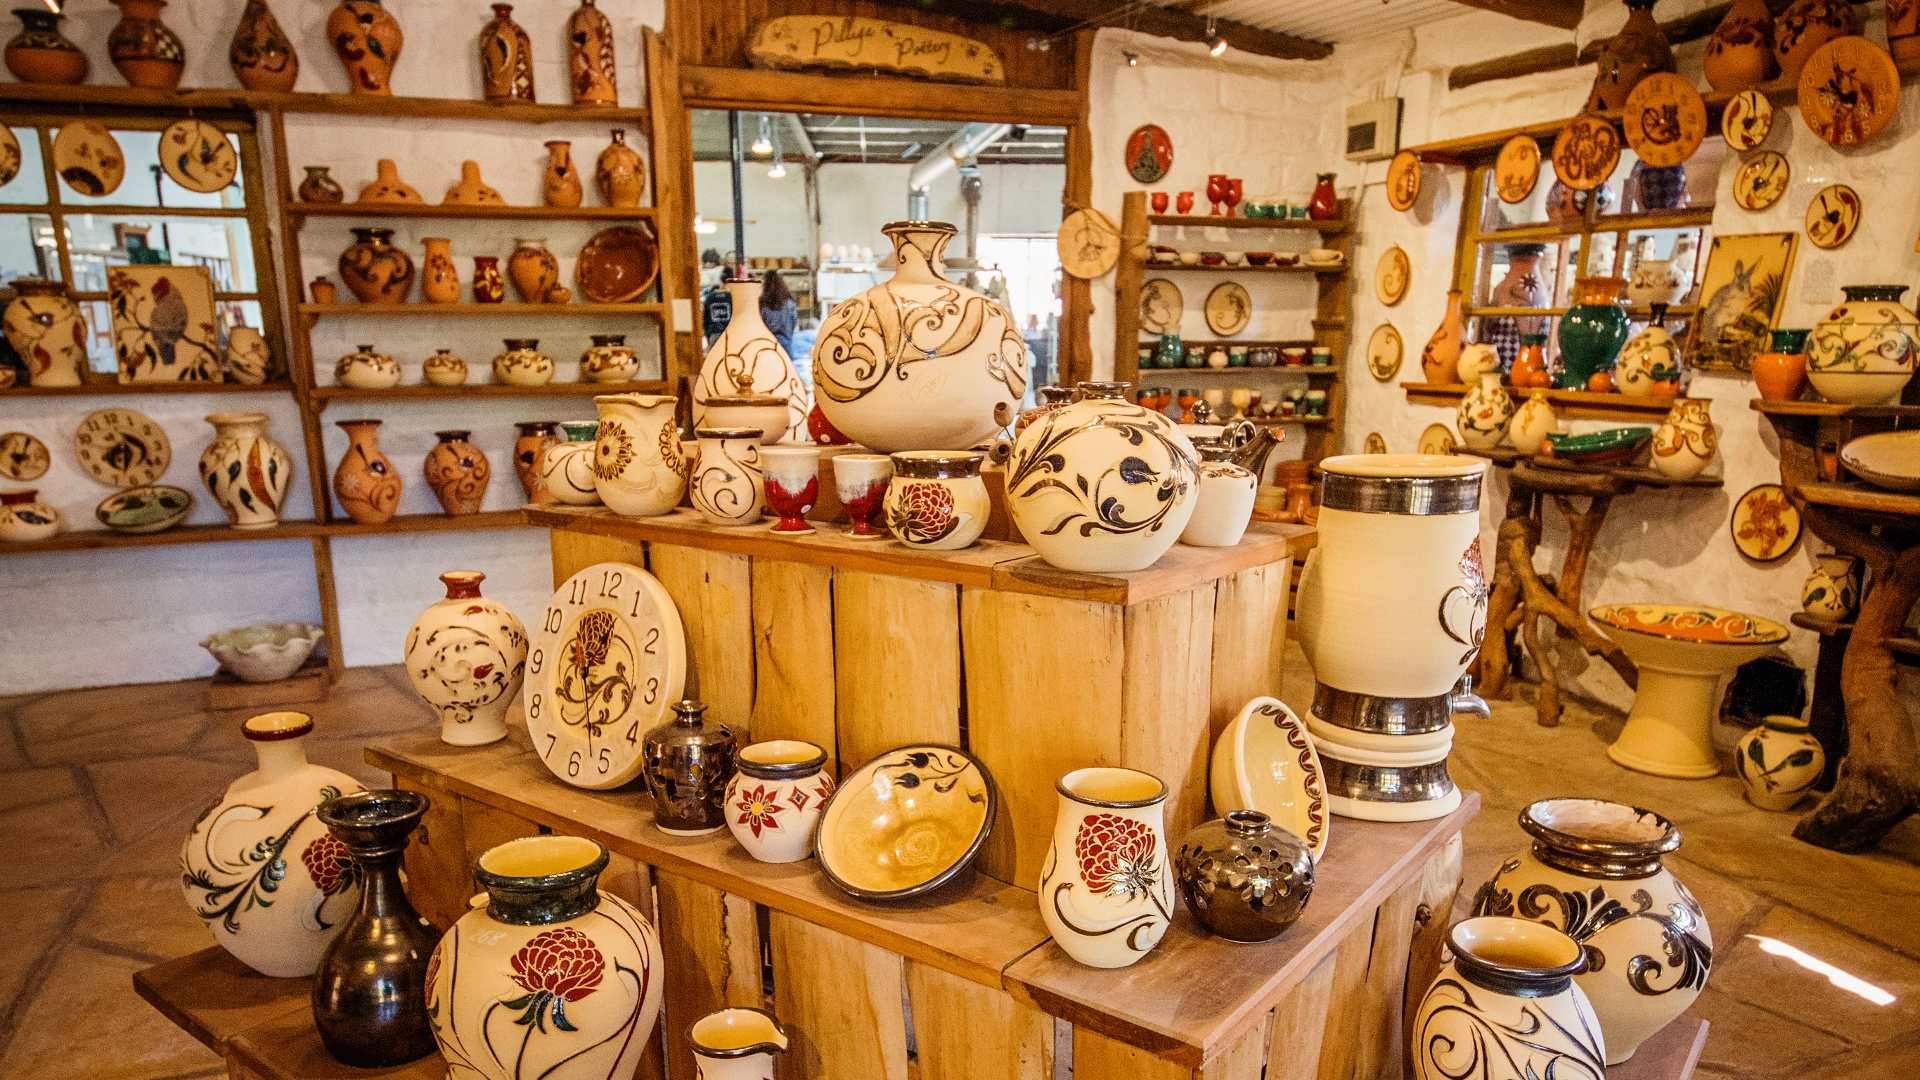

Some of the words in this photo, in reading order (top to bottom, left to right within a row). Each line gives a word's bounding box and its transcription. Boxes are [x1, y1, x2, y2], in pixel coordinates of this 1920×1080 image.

[1844, 128, 1853, 143] 6
[569, 579, 587, 605] 11
[600, 571, 622, 599] 12
[630, 590, 641, 618] 1
[544, 607, 563, 634] 10
[644, 628, 660, 655] 2
[531, 649, 544, 674] 9
[644, 677, 659, 705] 3
[530, 694, 542, 719] 8
[546, 733, 557, 760] 7
[626, 720, 639, 747] 4
[568, 751, 581, 777] 6
[597, 748, 611, 774] 5
